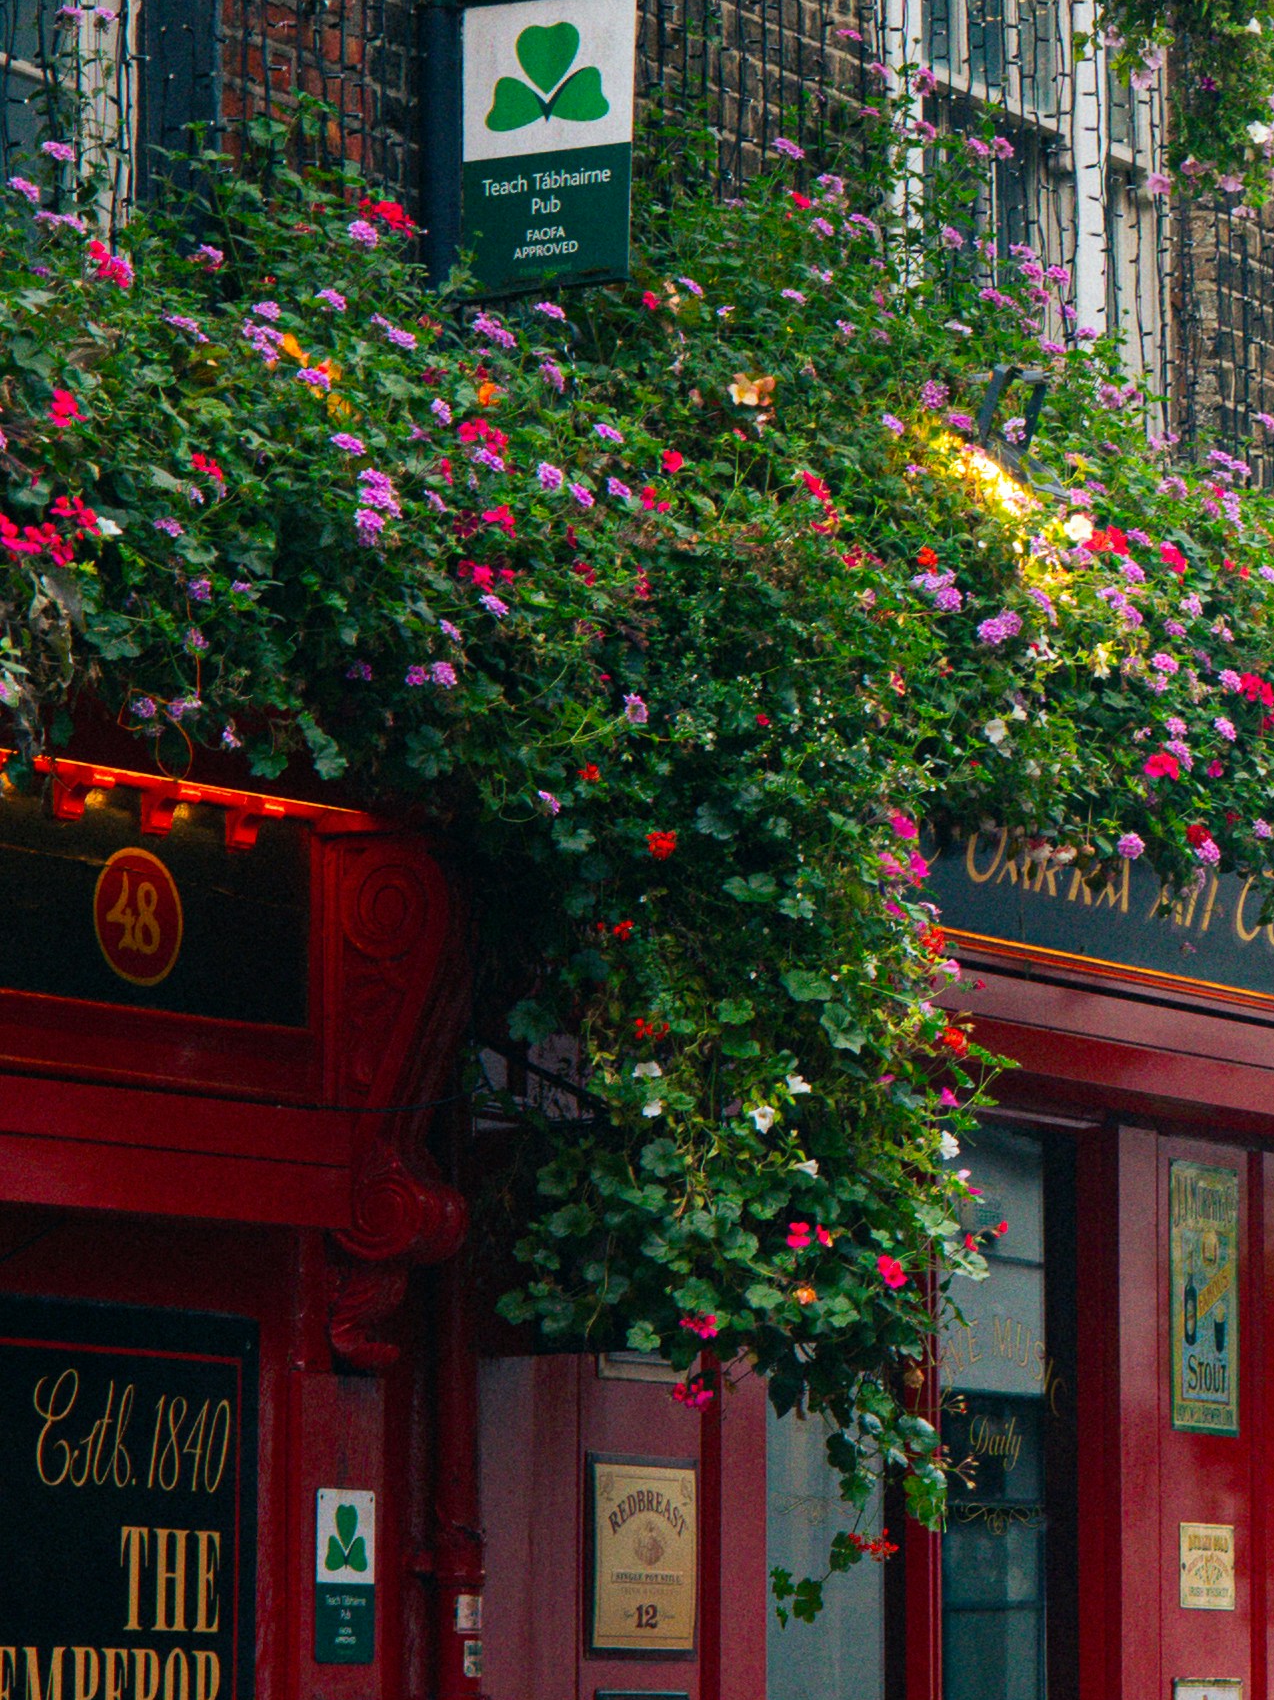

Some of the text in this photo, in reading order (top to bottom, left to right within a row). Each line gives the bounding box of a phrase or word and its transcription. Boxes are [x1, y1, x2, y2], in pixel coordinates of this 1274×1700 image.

[482, 175, 528, 197] Teach
[531, 198, 561, 215] Pub
[513, 240, 579, 260] APPROVED
[107, 870, 161, 955] 48
[147, 1393, 232, 1493] 1840
[968, 1413, 1022, 1467] Daily
[608, 1489, 688, 1538] REDBREAST
[119, 1526, 222, 1633] THE
[635, 1603, 659, 1629] 12
